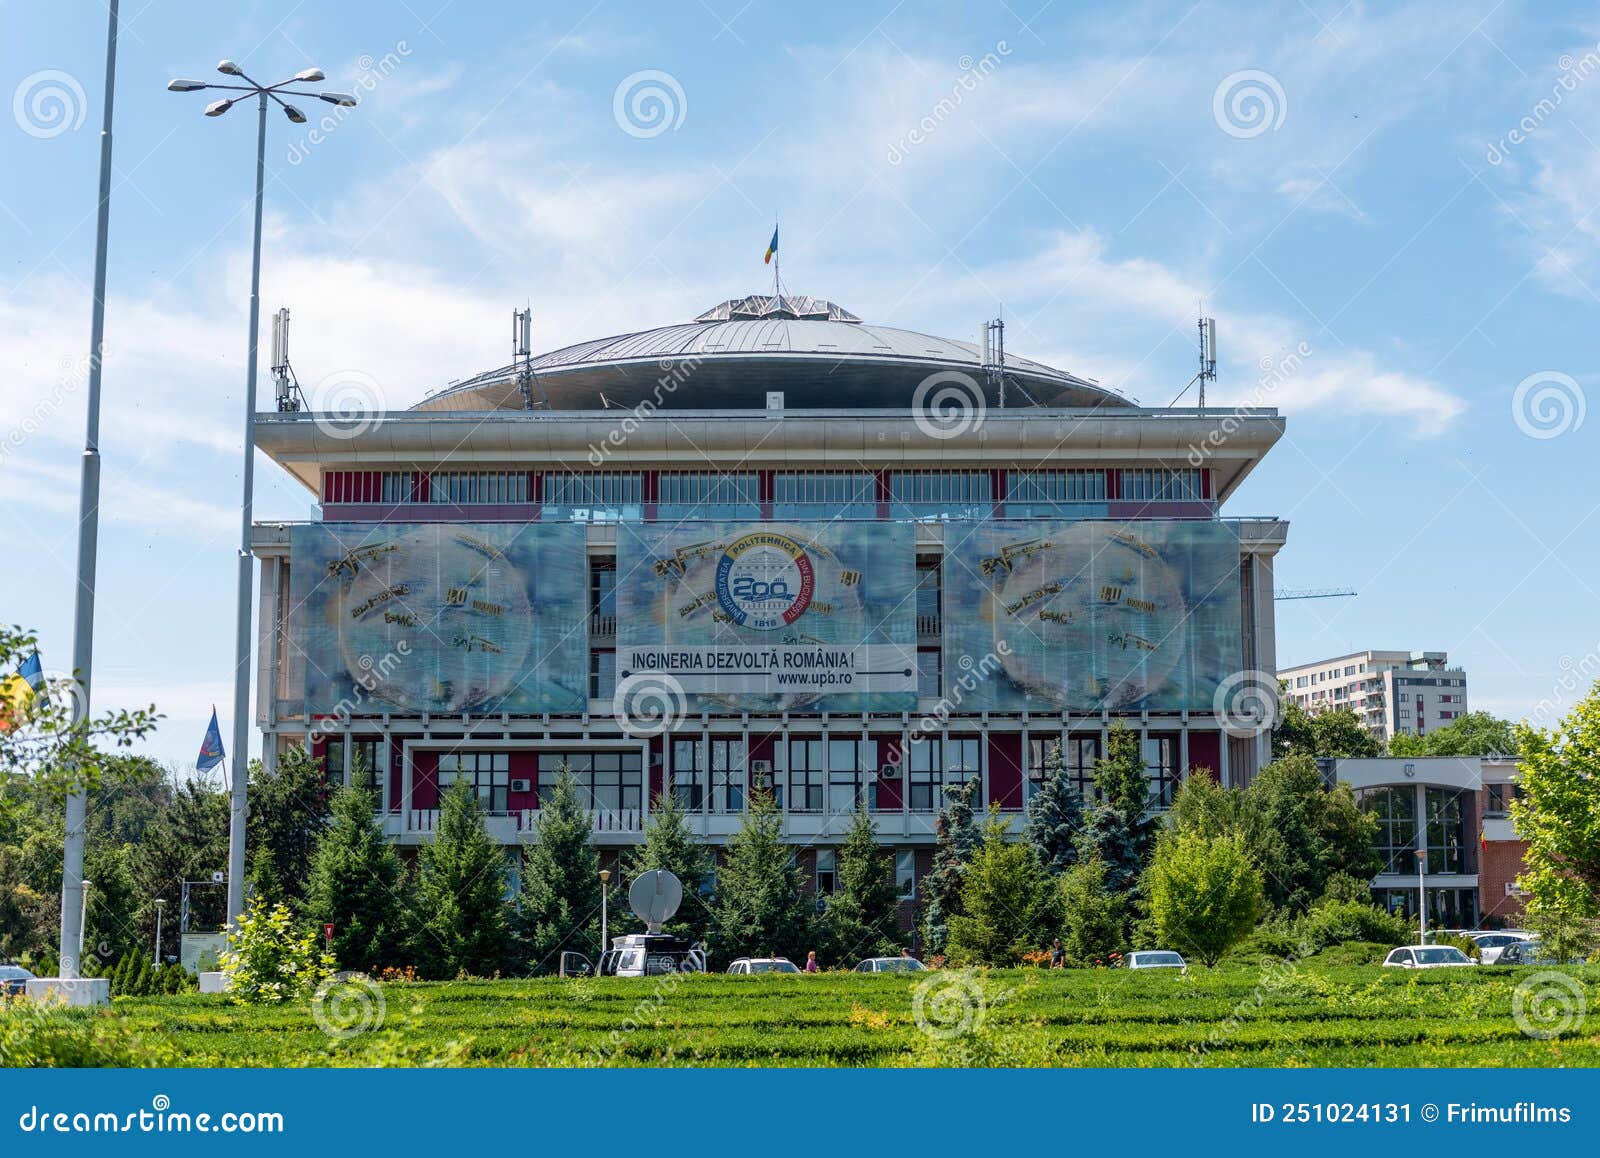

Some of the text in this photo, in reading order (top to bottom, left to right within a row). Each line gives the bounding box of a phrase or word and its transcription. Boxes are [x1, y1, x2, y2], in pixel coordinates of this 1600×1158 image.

[732, 536, 797, 555] POLITEHNICA
[733, 577, 788, 598] 200
[631, 652, 703, 669] INGINERIA
[707, 649, 779, 668] DEZVOLTĂ
[777, 671, 852, 687] www.upb.ro
